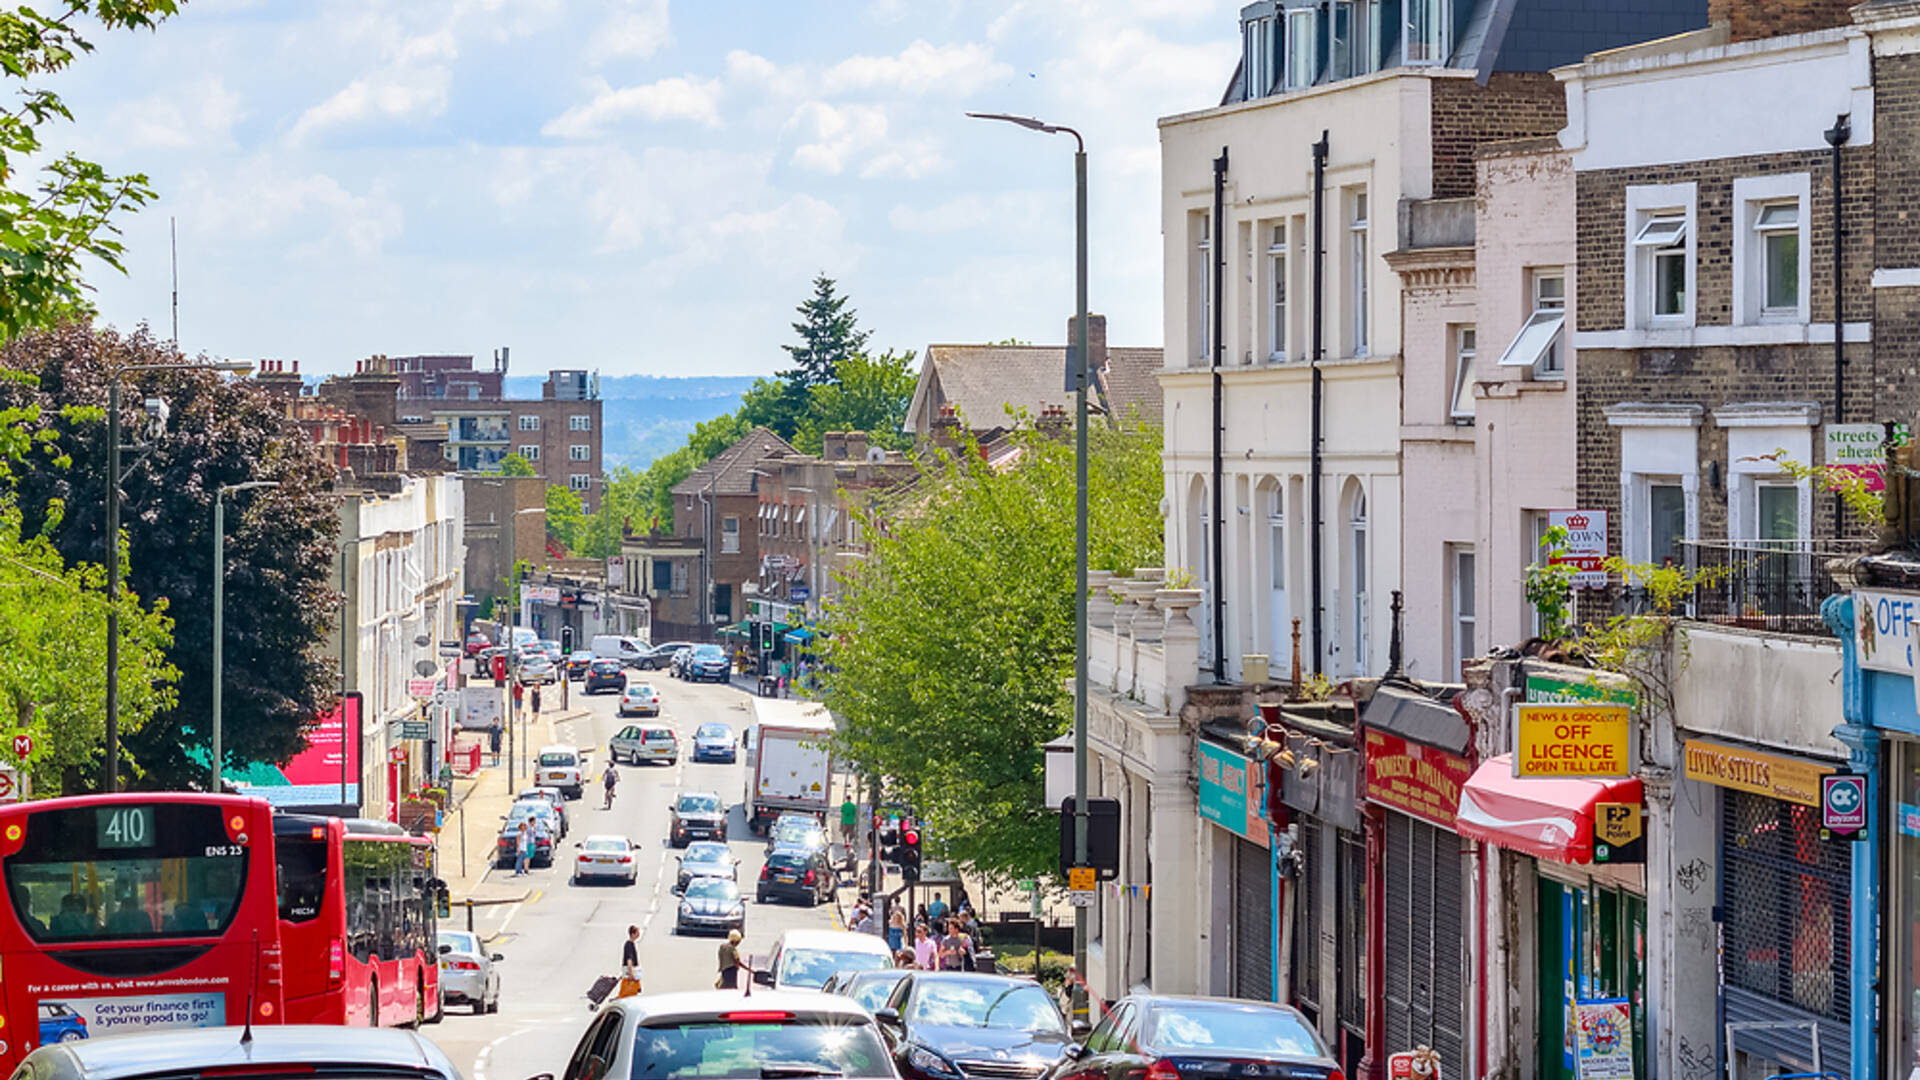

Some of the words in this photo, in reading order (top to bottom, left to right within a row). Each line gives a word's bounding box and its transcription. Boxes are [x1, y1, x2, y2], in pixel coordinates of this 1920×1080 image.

[1829, 432, 1878, 442] streets
[1837, 444, 1883, 458] ahead
[1562, 530, 1605, 542] OWN
[1582, 560, 1596, 569] BY
[1877, 597, 1914, 637] OFF
[1527, 713, 1558, 722] NEWS
[1561, 713, 1568, 722] &
[1554, 725, 1592, 740] OFF
[15, 739, 29, 752] M
[1532, 744, 1614, 759] LICENCE
[1375, 754, 1414, 780] DOMESTIC
[1526, 761, 1558, 772] OPEN
[1562, 761, 1587, 772] TILL
[1589, 761, 1617, 772] LATE
[1688, 747, 1726, 779] LIVING
[1728, 755, 1770, 788] STYLES
[106, 808, 144, 842] 410
[1607, 831, 1631, 839] Point
[205, 847, 227, 856] ENS
[230, 846, 243, 856] 23
[28, 985, 42, 993] For
[81, 982, 99, 991] with
[116, 980, 134, 989] visit
[95, 1004, 115, 1014] Get
[118, 1004, 143, 1016] your
[146, 1000, 190, 1012] finance
[192, 998, 215, 1010] first
[95, 1016, 103, 1025] &
[106, 1013, 141, 1027] you're
[144, 1010, 174, 1026] good
[176, 1011, 187, 1022] to
[190, 1011, 209, 1024] go!
